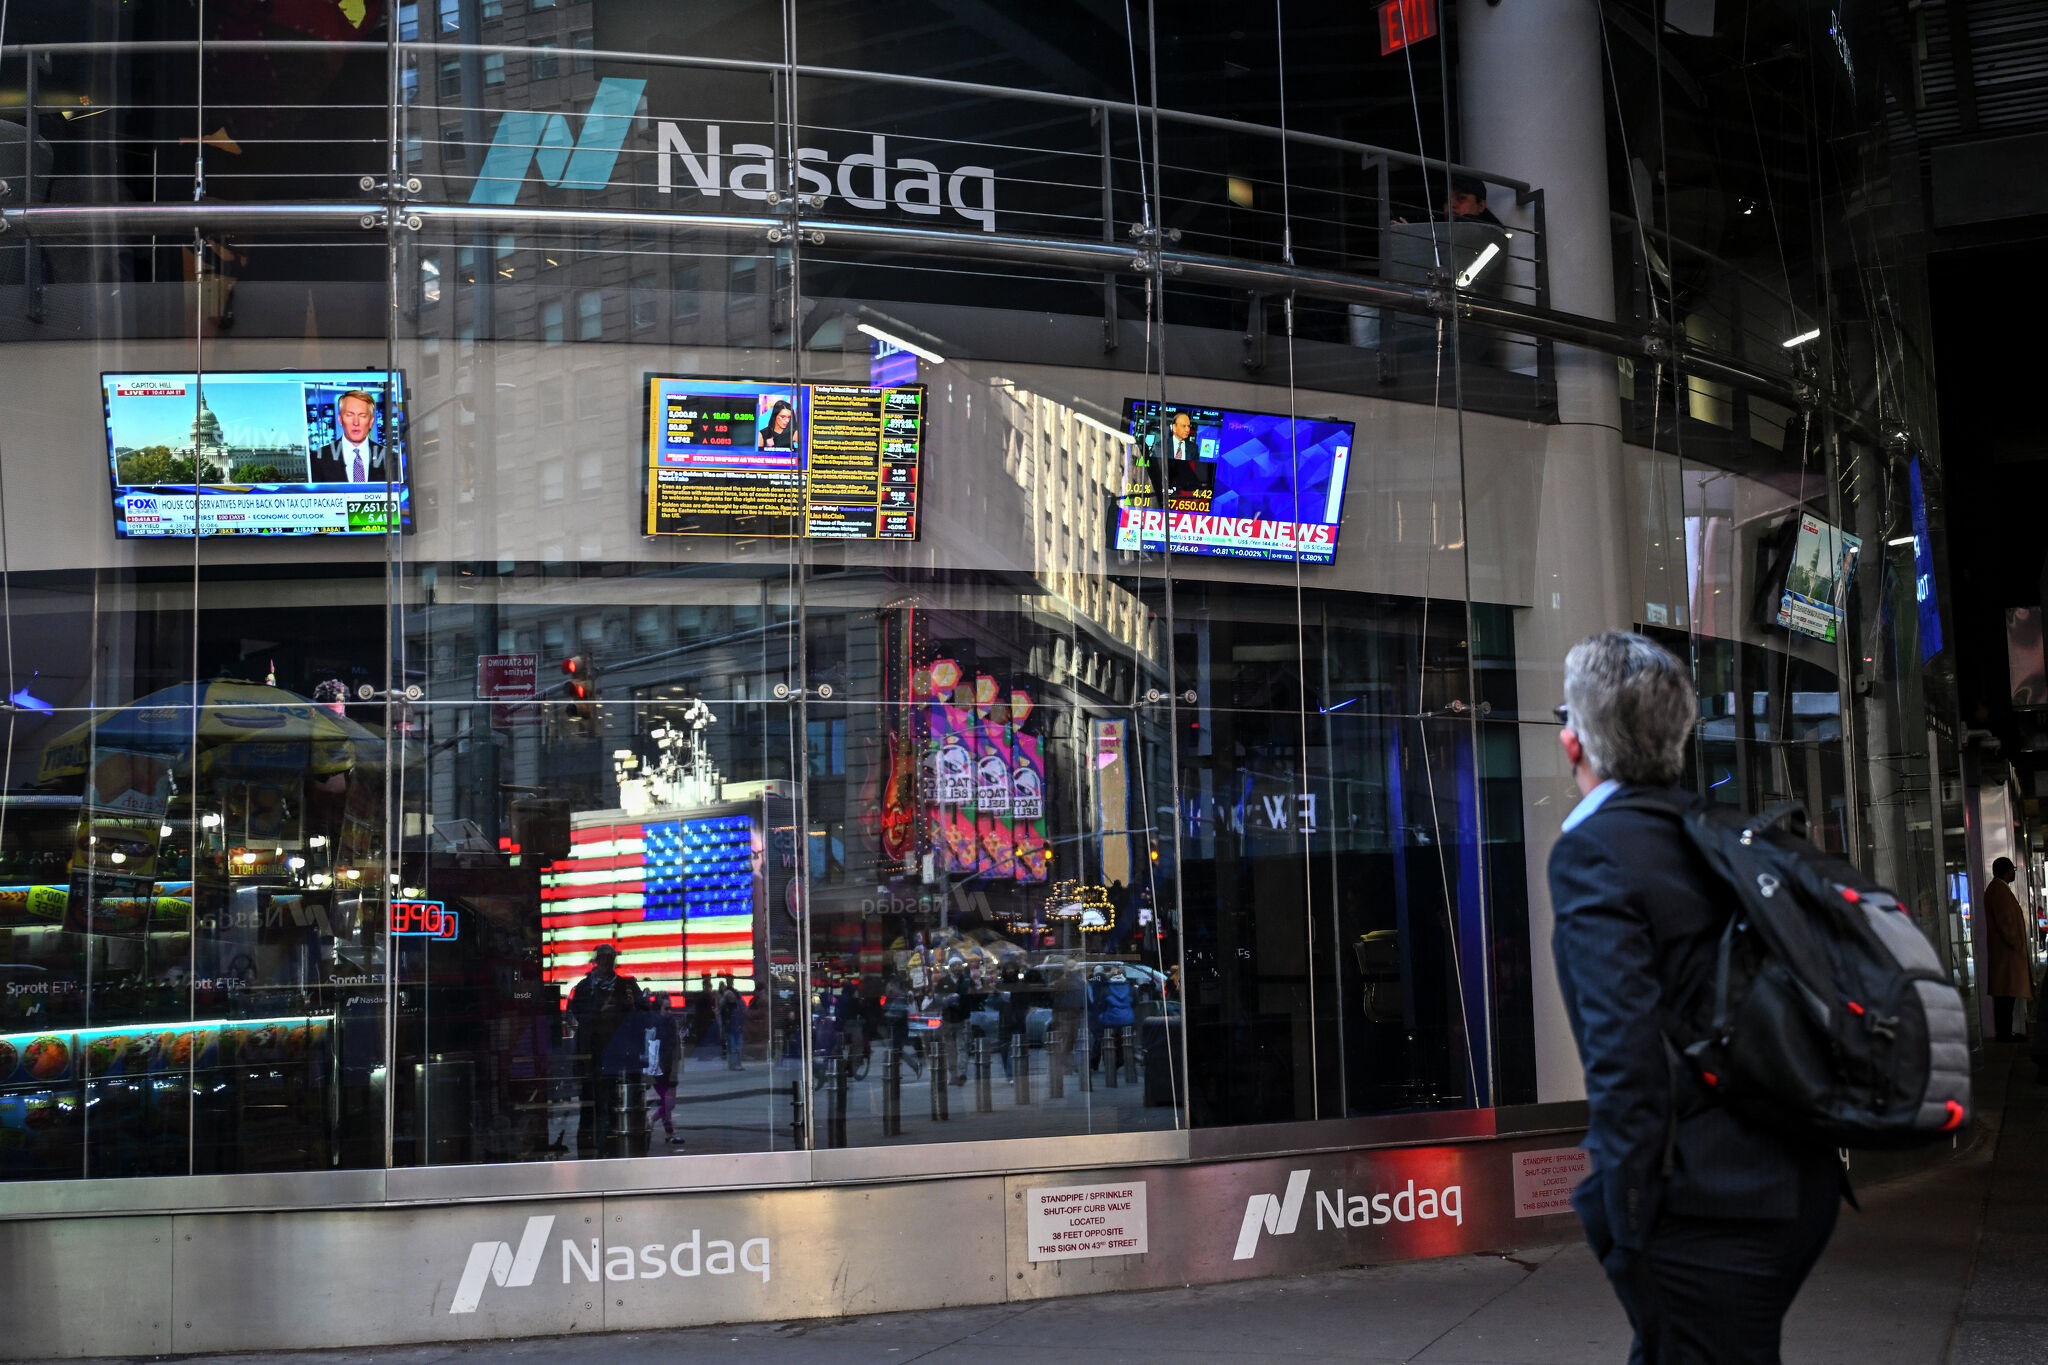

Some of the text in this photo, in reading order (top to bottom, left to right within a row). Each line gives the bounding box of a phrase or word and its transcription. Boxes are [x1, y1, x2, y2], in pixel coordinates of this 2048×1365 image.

[1386, 0, 1429, 49] EXIT
[656, 121, 996, 232] Nasdaq
[1126, 483, 1212, 499] 0.0% 4.42
[127, 499, 151, 508] FOX
[162, 498, 343, 509] HOUSE COSERVATIVES PUSH BACK ON TAX CUT PACKAGE
[1127, 509, 1330, 544] BREAKING NEWS
[329, 974, 368, 985] Sprott
[6, 981, 48, 997] Sprott
[1522, 1153, 1585, 1165] STANDPIPE SPRINKLER
[1525, 1168, 1551, 1176] SHUT-OFF
[1569, 1164, 1584, 1172] VALVE
[1544, 1177, 1568, 1186] LOCATED
[1041, 1194, 1083, 1203] STANDPIPE
[1090, 1190, 1133, 1200] SPRINKLER
[1044, 1203, 1131, 1215] SHUT-OFF CURB VALVE
[1315, 1178, 1463, 1231] Nasdaq
[1537, 1201, 1550, 1209] SIGN
[1070, 1217, 1105, 1226] LOCATED
[1064, 1231, 1082, 1239] FEET
[1085, 1228, 1124, 1238] OPPOSITE
[1038, 1245, 1056, 1253] THIS
[1058, 1244, 1076, 1252] SIGN
[1108, 1239, 1138, 1248] STREET
[561, 1228, 771, 1284] Nasdaq
